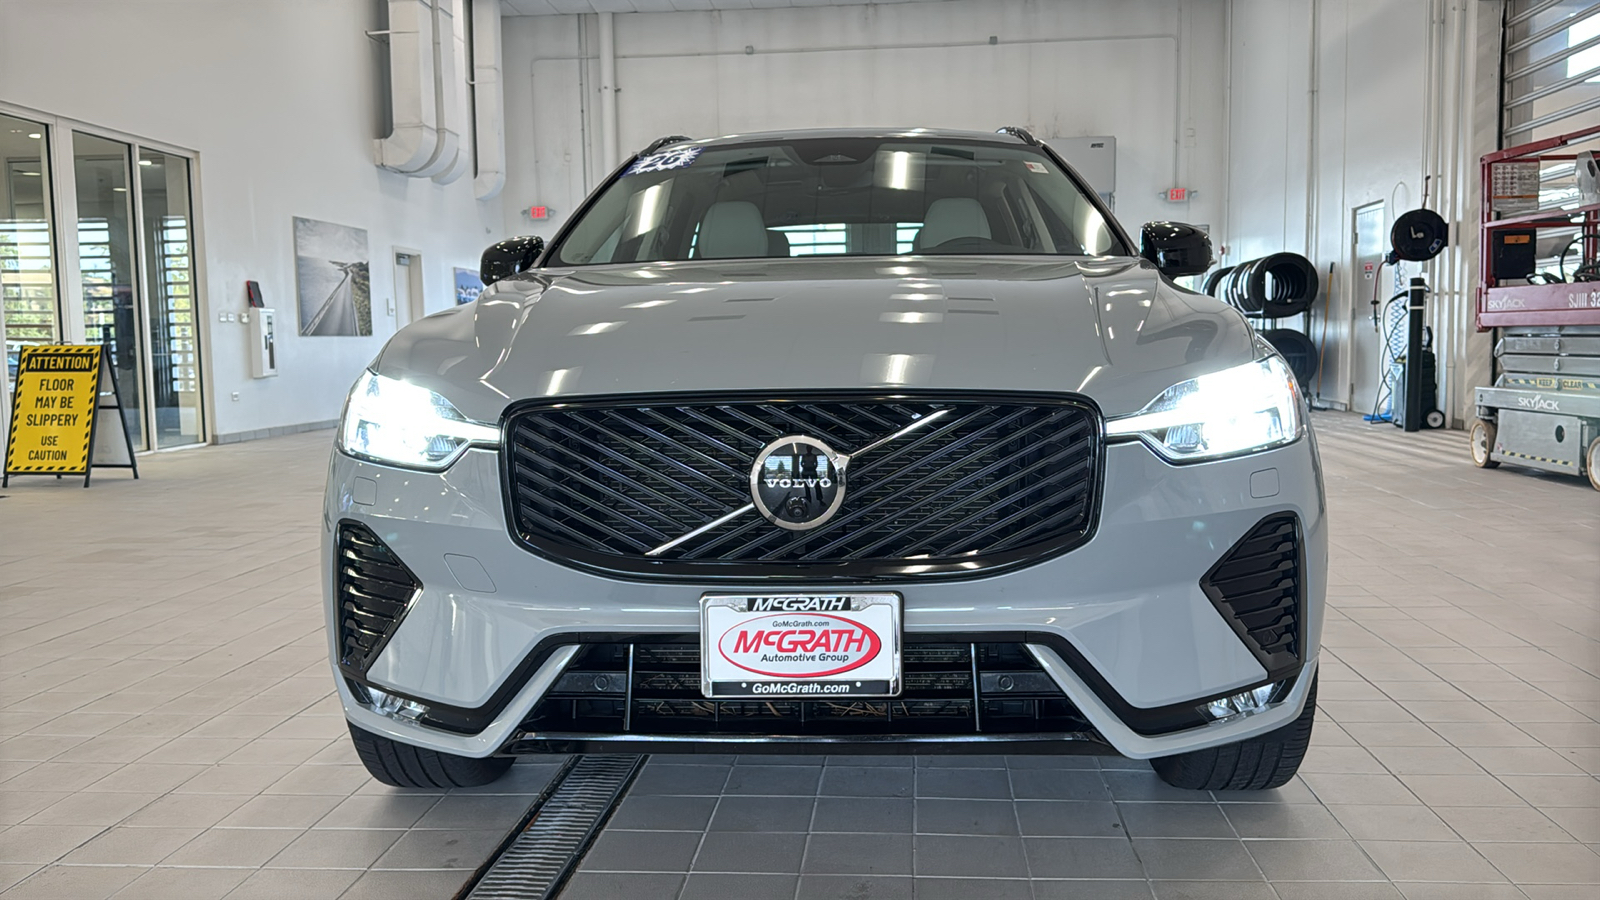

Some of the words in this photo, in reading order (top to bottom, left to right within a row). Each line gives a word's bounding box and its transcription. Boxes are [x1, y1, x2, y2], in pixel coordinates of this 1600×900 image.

[1170, 188, 1185, 200] EXIT
[531, 206, 545, 218] EXIT
[1487, 294, 1525, 310] SKYJACK
[28, 356, 90, 369] ATTENTION
[39, 379, 74, 391] FLOOR
[1563, 380, 1582, 388] CLEAR
[34, 396, 56, 409] MAY
[60, 396, 74, 408] BE
[1518, 394, 1559, 410] SKYJACK
[26, 414, 78, 426] SLIPPERY
[41, 436, 58, 446] USE
[28, 450, 67, 461] CAUTION
[763, 478, 832, 488] VOLVO
[753, 597, 846, 611] McGRATH
[772, 620, 829, 628] GoMcGrath.com
[733, 630, 866, 653] McGRATH
[760, 653, 816, 662] Automotive
[818, 653, 849, 663] Group
[752, 683, 850, 694] GoMcGrath.com
